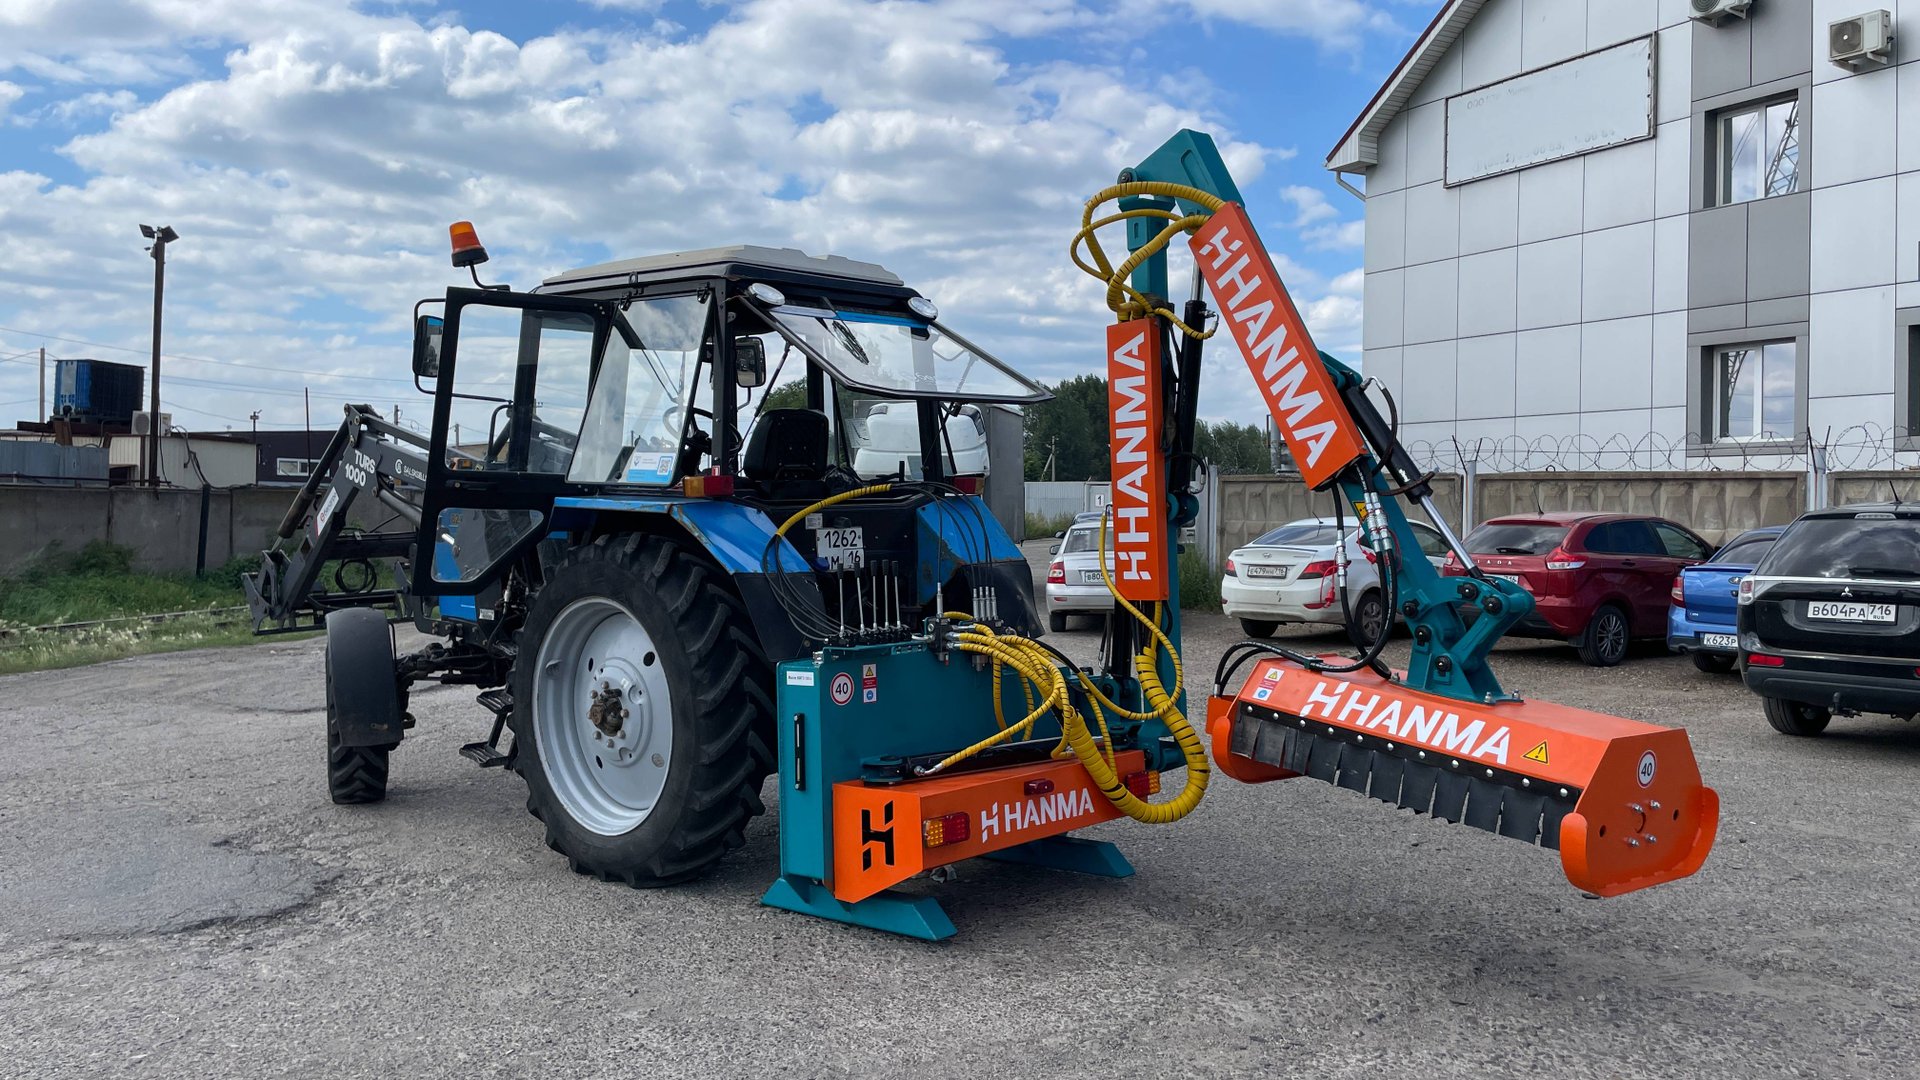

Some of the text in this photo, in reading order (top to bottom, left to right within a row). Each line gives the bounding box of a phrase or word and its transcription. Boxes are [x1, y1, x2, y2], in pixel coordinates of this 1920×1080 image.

[1216, 253, 1338, 469] HANMA
[1113, 331, 1150, 543] HANMA
[354, 449, 376, 474] TURS
[345, 463, 366, 487] 1000
[1097, 495, 1102, 505] 1
[824, 530, 858, 548] 1262
[848, 550, 861, 563] 16
[1869, 604, 1892, 616] 716
[835, 682, 849, 695] 40
[1336, 690, 1510, 765] HANMA
[1640, 762, 1653, 777] 40
[1004, 787, 1095, 832] HANMA
